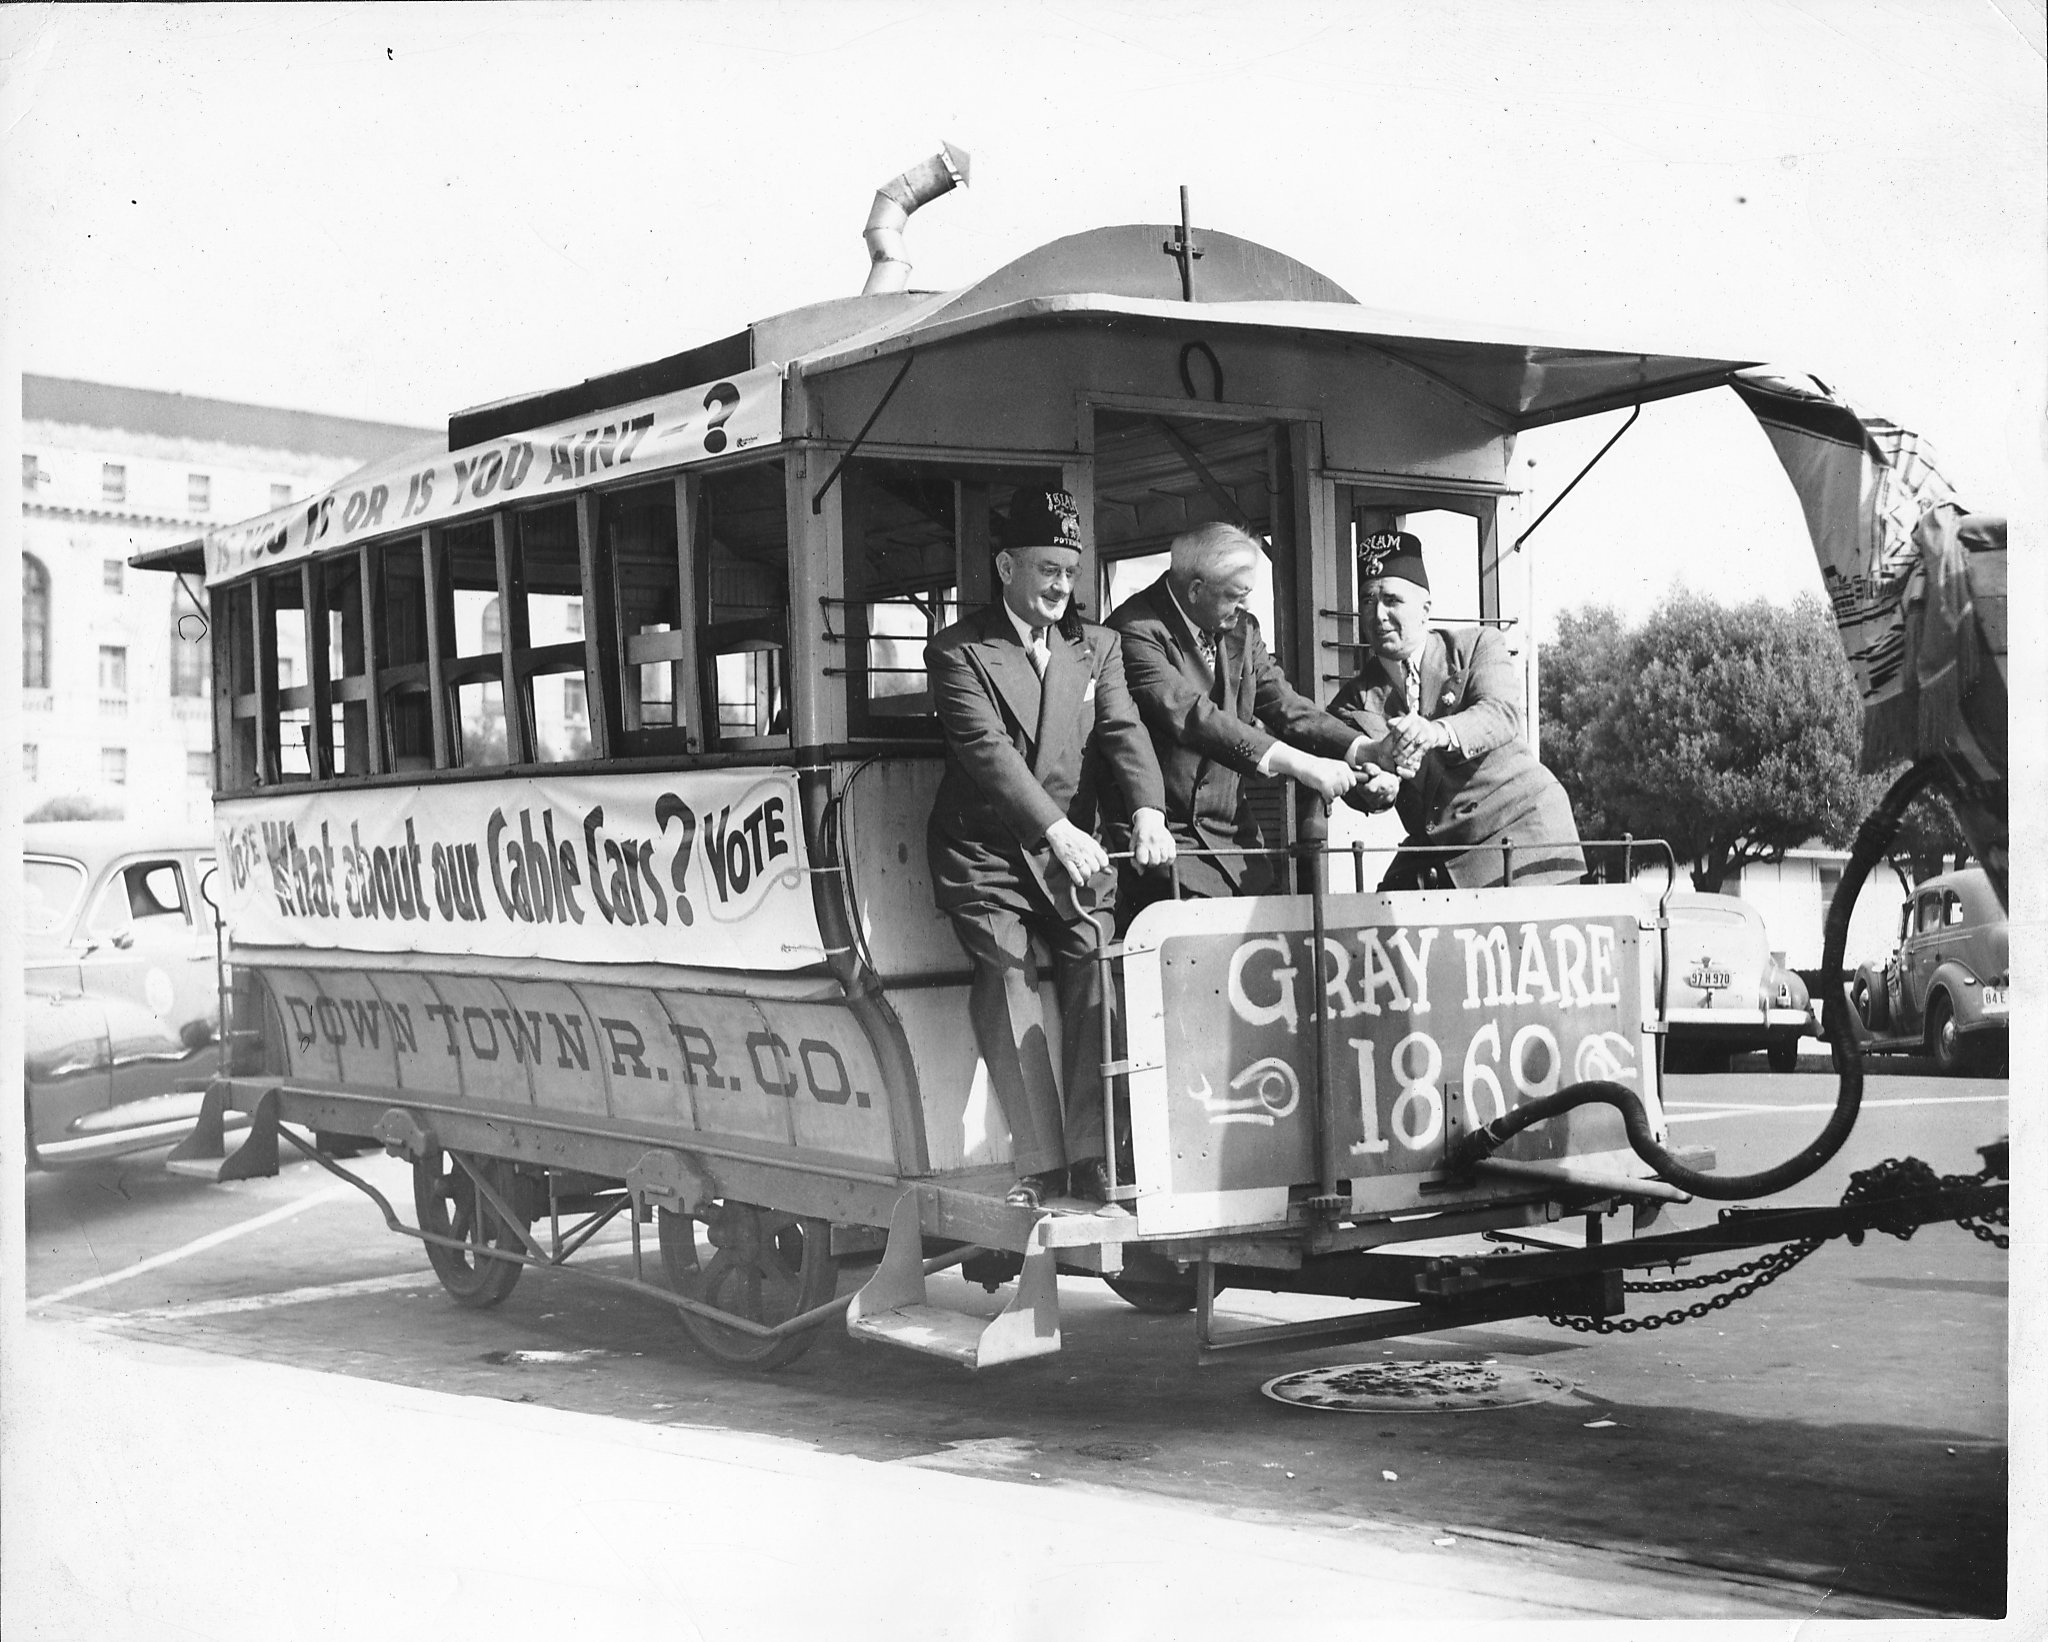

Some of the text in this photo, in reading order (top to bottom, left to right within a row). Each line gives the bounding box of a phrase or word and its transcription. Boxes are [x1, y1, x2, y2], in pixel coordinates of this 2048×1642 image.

[303, 496, 335, 546] IS
[343, 484, 389, 533] OR
[401, 470, 436, 518] IS
[452, 441, 534, 504] YOU
[223, 824, 260, 894] VOTE
[261, 820, 340, 918] What
[343, 817, 431, 922] about
[432, 841, 486, 921] our
[487, 807, 586, 925] Cable
[704, 796, 788, 903] VOTE
[1229, 922, 1621, 1033] GRAY MARE
[1692, 972, 1729, 986] 97 H 970
[284, 995, 417, 1053] DOWN
[428, 1005, 591, 1071] TOWN
